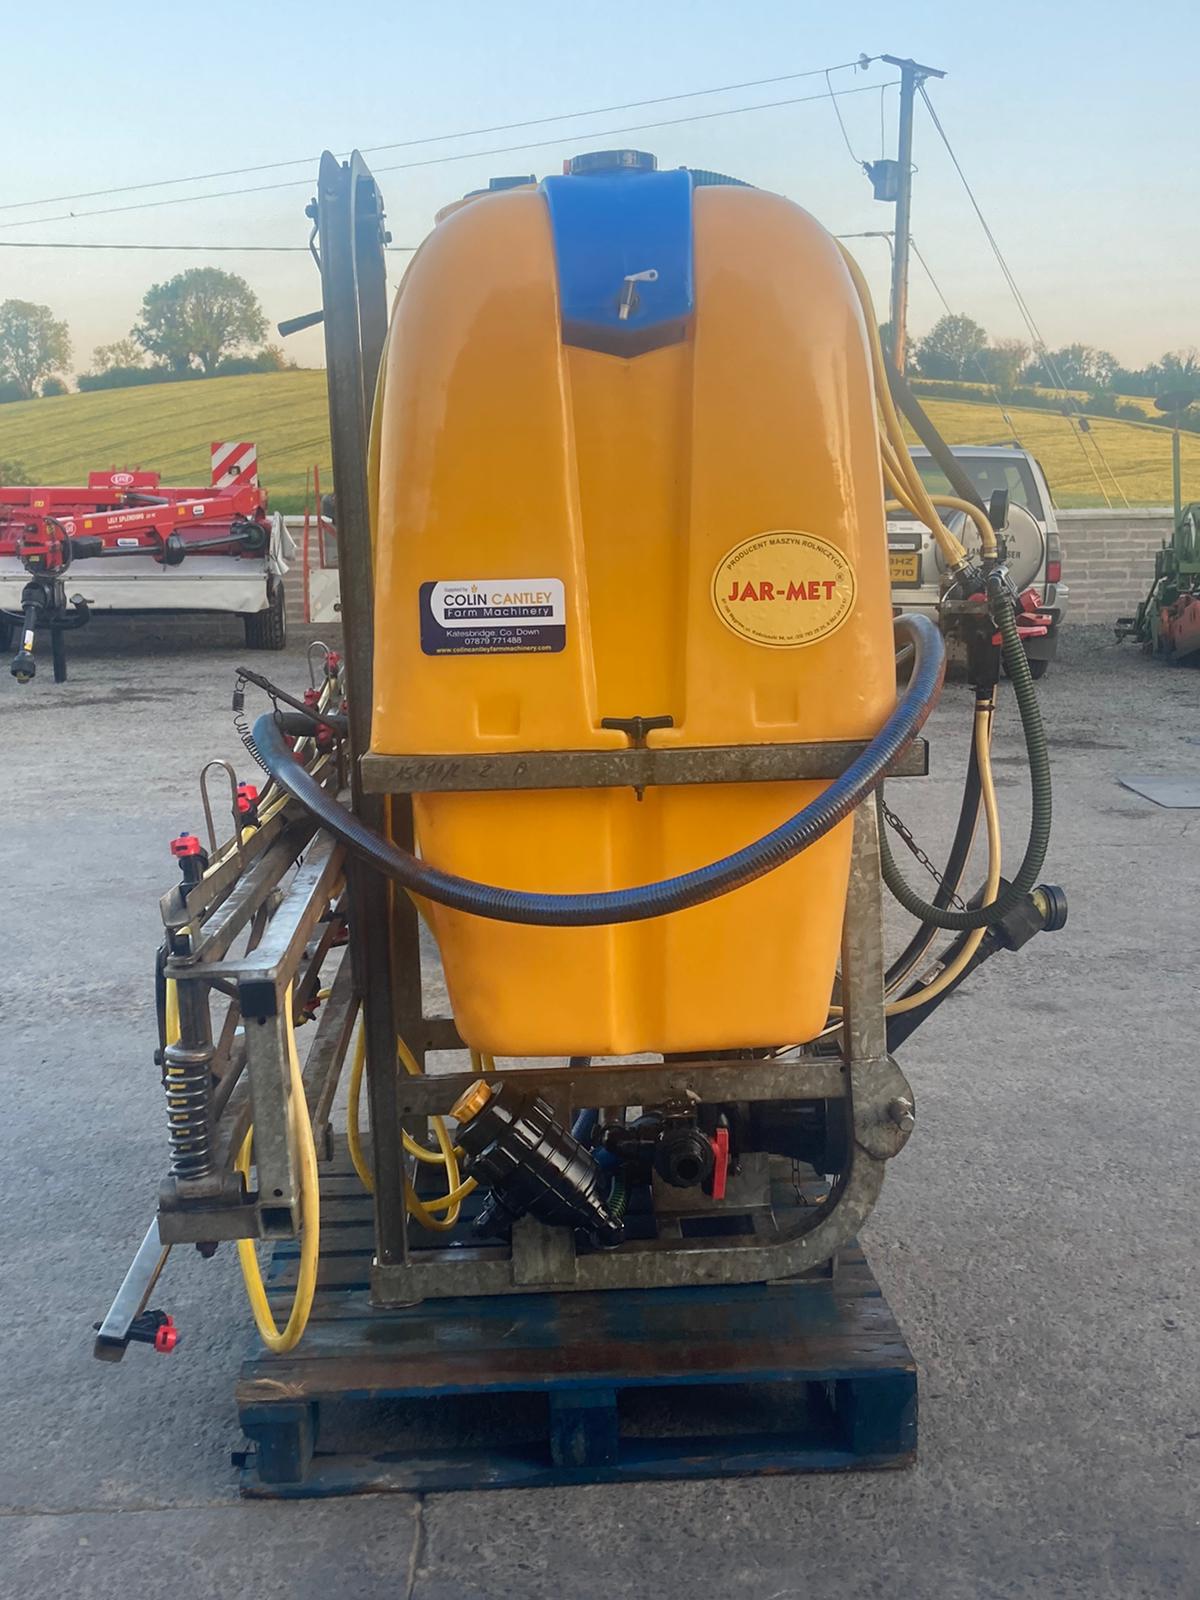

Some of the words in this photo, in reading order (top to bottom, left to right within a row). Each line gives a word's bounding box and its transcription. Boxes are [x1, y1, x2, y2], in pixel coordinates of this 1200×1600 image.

[726, 540, 767, 570] PRODUCENT
[802, 540, 843, 570] ROLNICZYCH
[728, 580, 836, 601] JAR-MET
[444, 593, 487, 606] COLIN
[491, 592, 552, 605] CANTLEY
[447, 608, 478, 618] Farm
[483, 606, 550, 617] Machinery
[516, 628, 540, 636] Down
